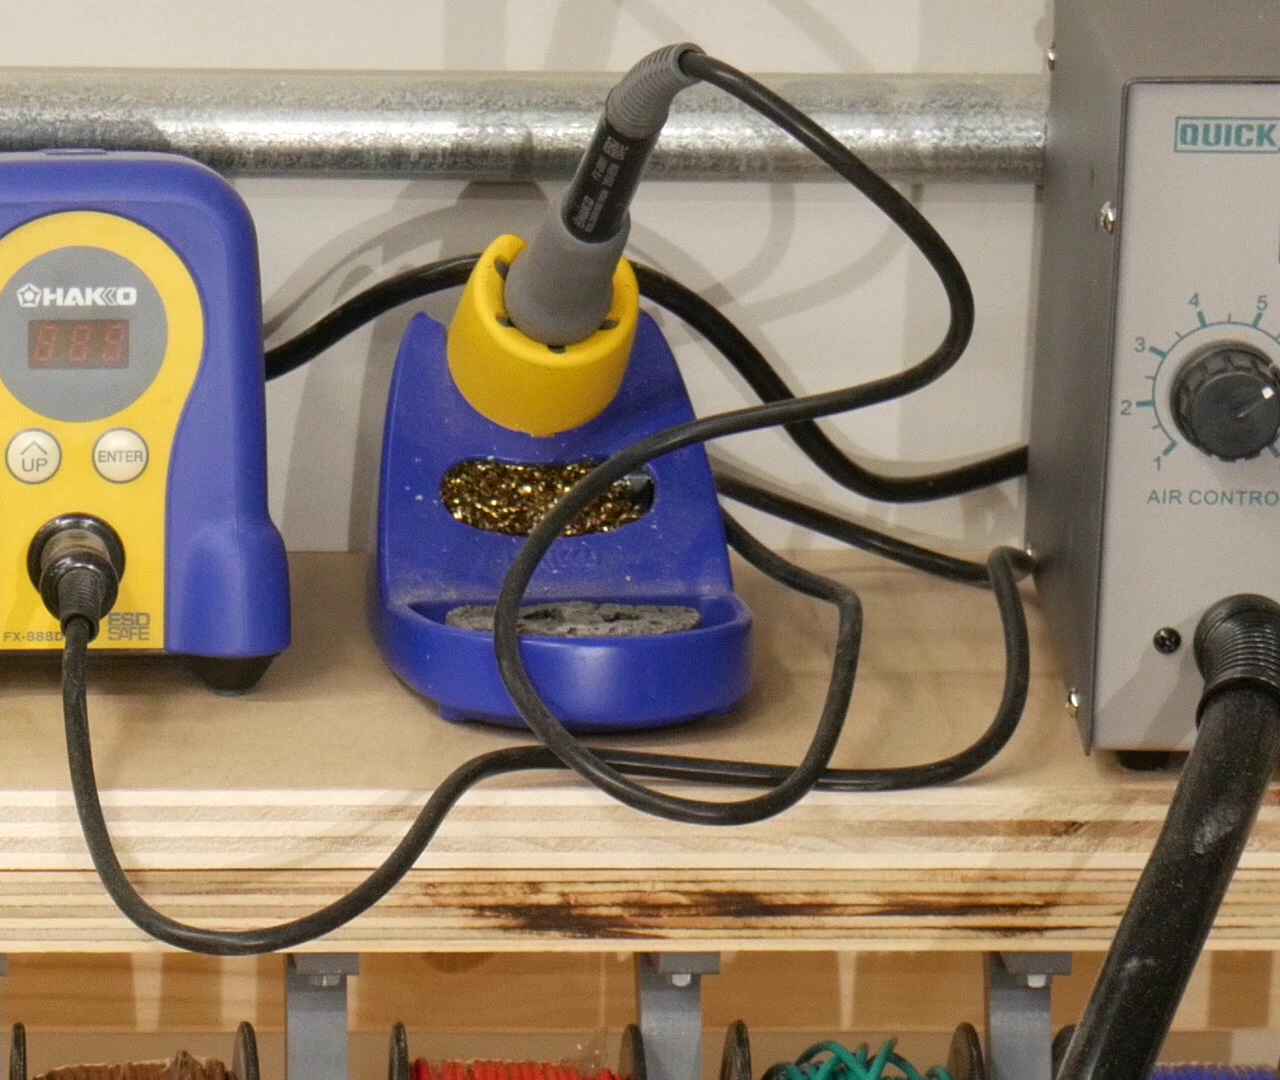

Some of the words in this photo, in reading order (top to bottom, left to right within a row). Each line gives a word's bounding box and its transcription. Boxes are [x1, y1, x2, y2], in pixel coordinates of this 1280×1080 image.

[1180, 123, 1277, 147] QUICK
[43, 286, 138, 306] HAKKO
[1188, 292, 1200, 308] 4
[1256, 295, 1268, 311] 5
[1134, 336, 1146, 352] 3
[1120, 400, 1132, 416] 2
[97, 450, 143, 463] ENTER
[1153, 455, 1162, 471] 1
[21, 457, 48, 473] UP
[1147, 490, 1182, 505] AIR
[1189, 490, 1280, 506] CONTRO
[107, 612, 151, 626] ESD
[3, 631, 64, 642] FX-888D
[107, 626, 151, 641] SAFE
